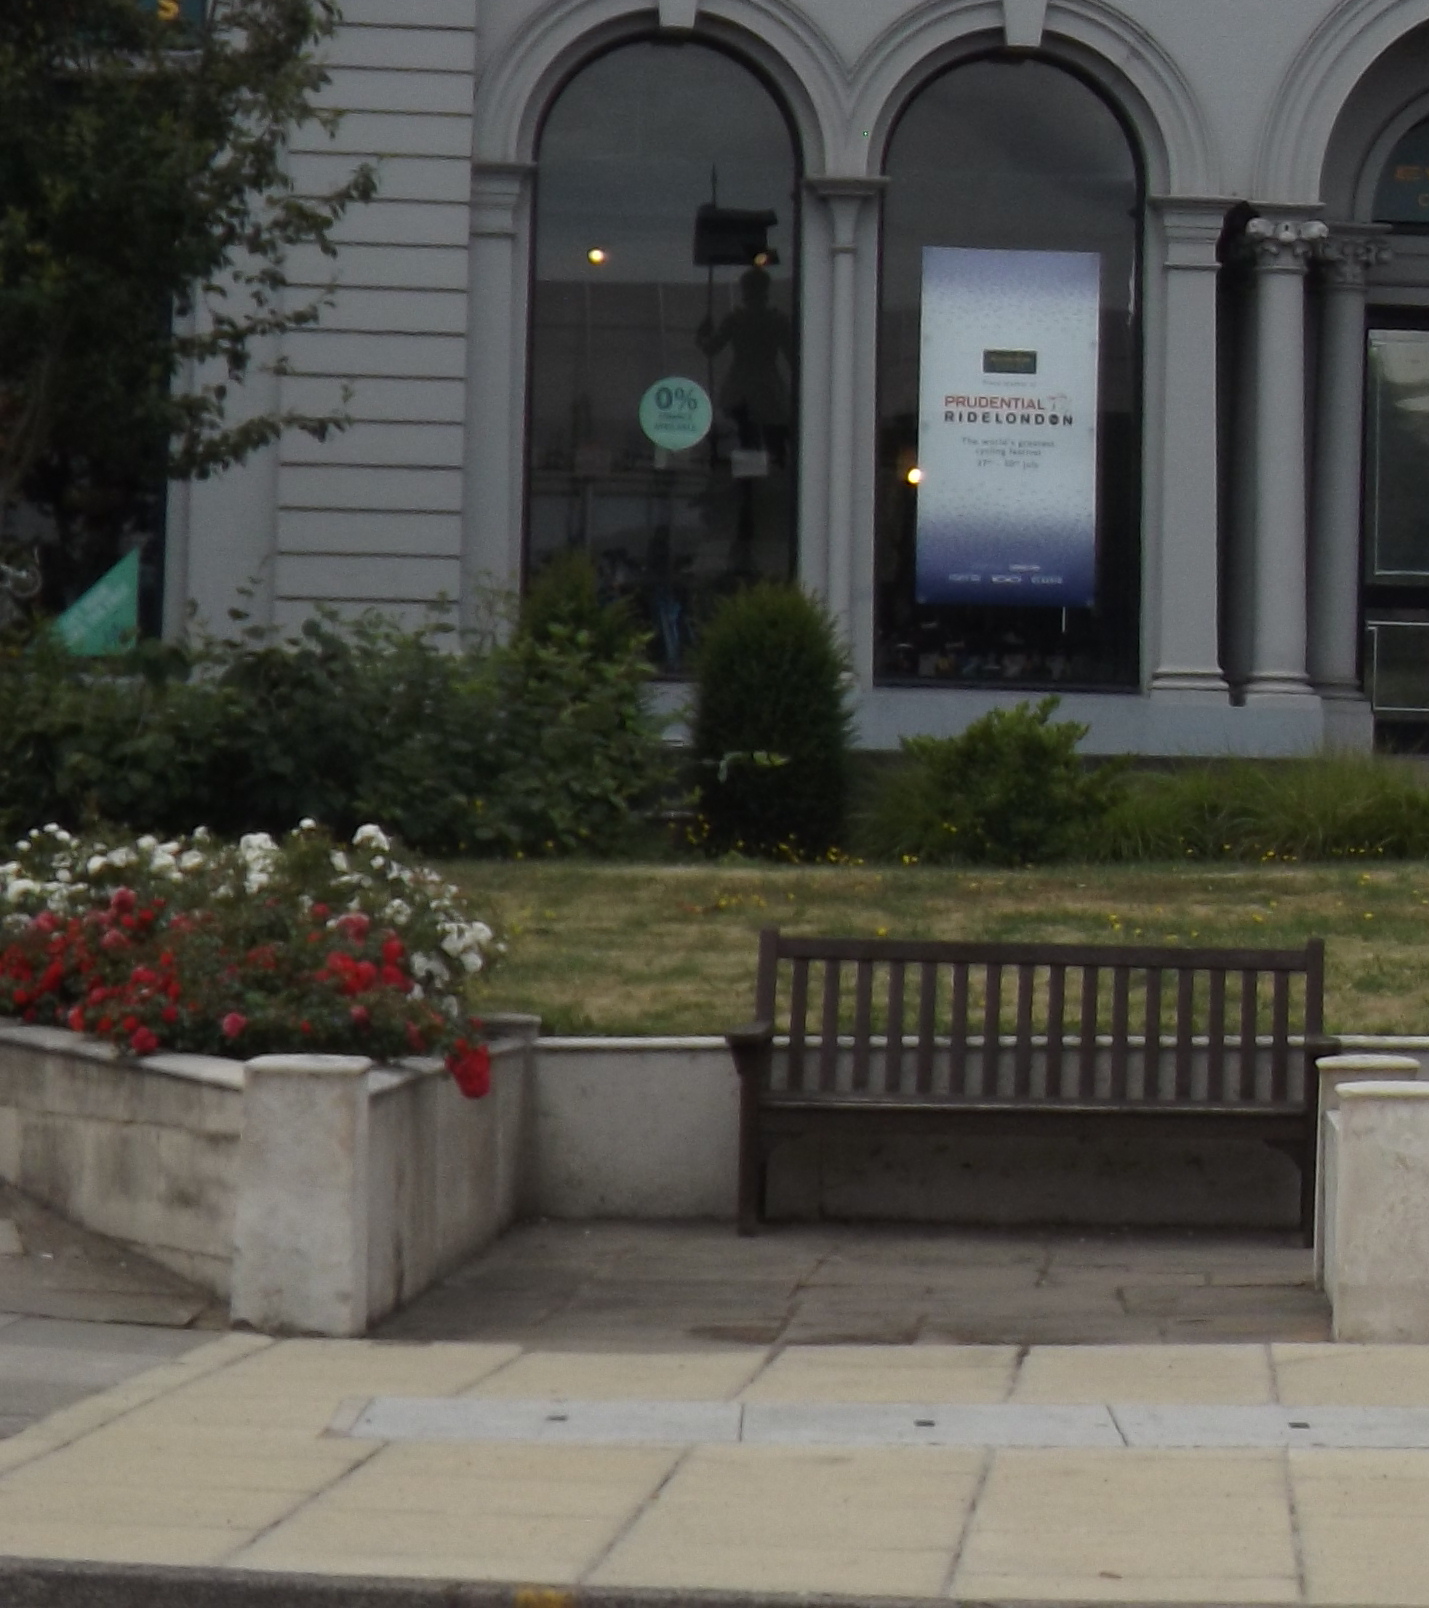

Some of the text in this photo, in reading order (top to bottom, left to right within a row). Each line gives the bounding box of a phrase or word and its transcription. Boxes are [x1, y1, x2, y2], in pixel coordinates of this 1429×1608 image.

[656, 387, 698, 410] 0%
[944, 395, 1044, 410] PRUDENTIAL
[944, 411, 1073, 426] RIDELONDON
